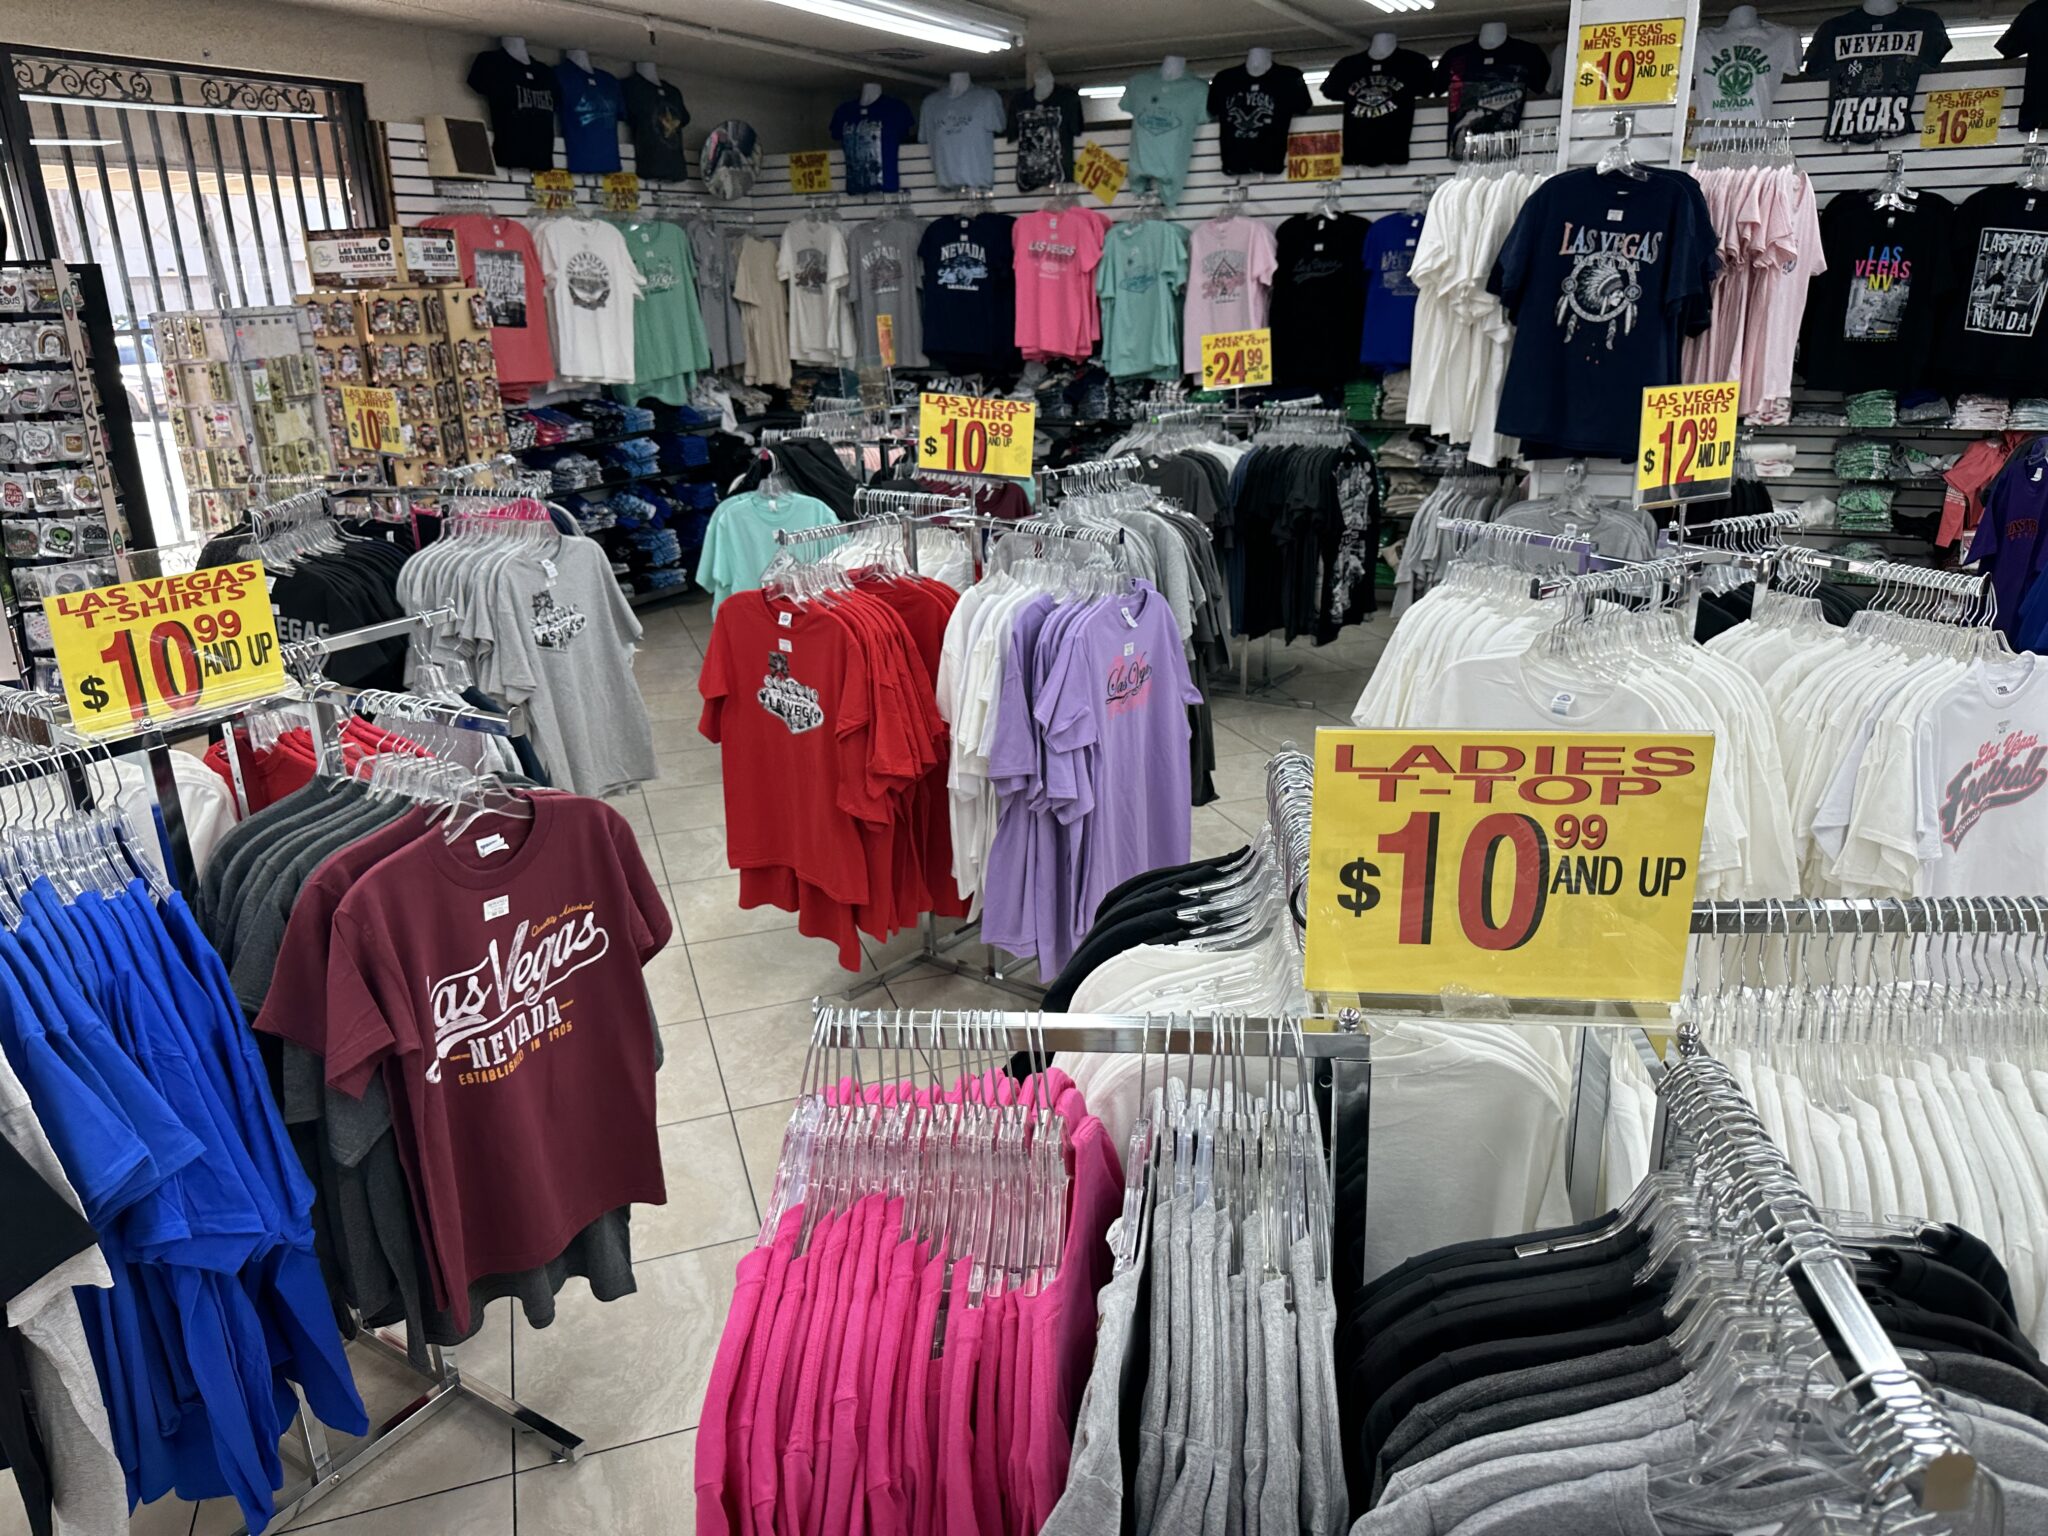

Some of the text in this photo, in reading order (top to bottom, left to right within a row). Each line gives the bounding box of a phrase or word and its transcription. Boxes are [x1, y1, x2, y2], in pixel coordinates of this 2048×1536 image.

[1584, 33, 1677, 50] MEN'S T-SHIRS
[1593, 23, 1663, 38] LAS VEGAS
[1839, 34, 1917, 57] NEVADA
[1637, 64, 1674, 78] AND UP
[1703, 45, 1771, 76] LAS VEGAS
[1712, 98, 1754, 109] NEVADA
[1929, 89, 1999, 103] LAS VEGAS
[1829, 97, 1908, 136] VEGAS
[1968, 117, 1996, 129] AND UP
[338, 246, 377, 255] LAS VEGAS
[941, 243, 986, 263] NEVADA
[1047, 243, 1076, 256] VEGAS
[1559, 222, 1663, 264] LAS VEGAS
[1869, 246, 1903, 263] LAS
[1982, 232, 2048, 255] LAS VEGA
[339, 253, 392, 263] ORNAMENTS
[1855, 260, 1912, 279] VEGAS
[1868, 274, 1893, 291] NV
[1972, 307, 2029, 331] NEVADA
[1248, 348, 1263, 366] 99
[364, 390, 393, 401] VEGAS
[924, 394, 1031, 413] LAS VEGAS
[1648, 387, 1735, 407] LAS VEGAS
[73, 349, 111, 489] FUNATIC
[939, 404, 1015, 421] T-SHIRT
[1656, 400, 1730, 419] T-SHIRTS
[988, 422, 1013, 437] 99
[1698, 417, 1718, 442] 99
[986, 436, 1013, 447] AND UP
[1696, 441, 1731, 468] AND UP
[57, 564, 257, 616] LAS VEGAS
[75, 583, 247, 629] T-SHIRTS
[193, 609, 242, 643] 99
[276, 616, 328, 641] EGAS
[204, 631, 273, 678] AND UP
[1335, 744, 1694, 777] LADIES
[1974, 730, 2038, 771] Las Vegas
[1358, 774, 1661, 805] T-TOP
[1939, 745, 2048, 835] Football
[1554, 814, 1608, 850] 99
[1550, 856, 1686, 897] AND UP
[489, 911, 609, 1007] Vegas
[468, 996, 561, 1069] NEVADA
[531, 1037, 541, 1052] IN
[549, 1020, 573, 1042] 1905
